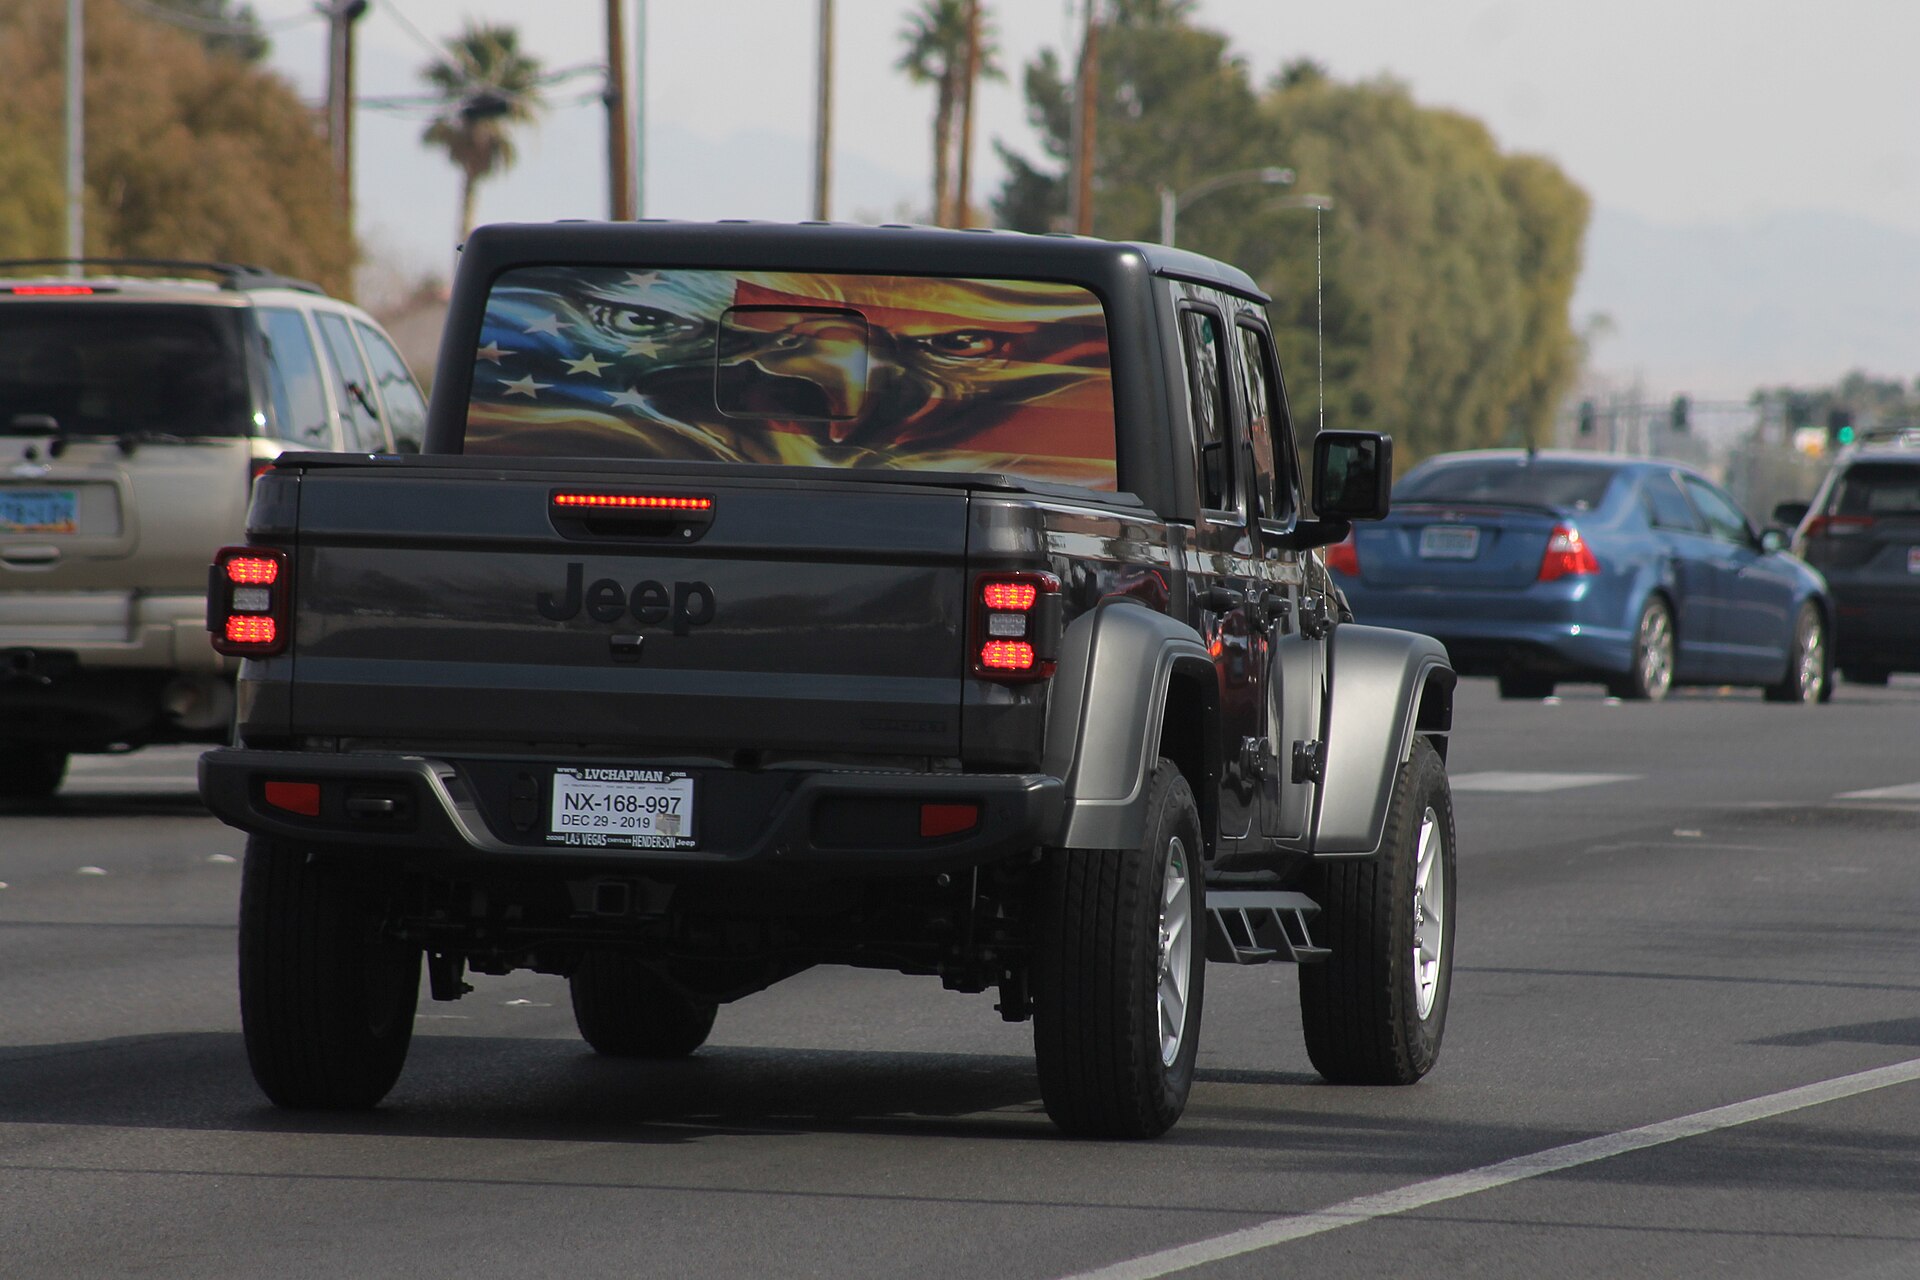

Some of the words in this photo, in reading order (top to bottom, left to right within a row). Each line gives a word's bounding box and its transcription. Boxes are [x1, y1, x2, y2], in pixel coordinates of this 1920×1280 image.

[537, 562, 716, 637] Jeep
[585, 768, 664, 782] LVCHAPMAN
[564, 792, 682, 814] NX-168-997
[561, 814, 590, 826] DEC
[593, 815, 609, 827] 29
[620, 816, 651, 829] 2019
[565, 833, 581, 845] LAS
[582, 833, 607, 846] VEGAS
[632, 835, 676, 848] HENDERSON
[676, 839, 696, 847] Jeep
